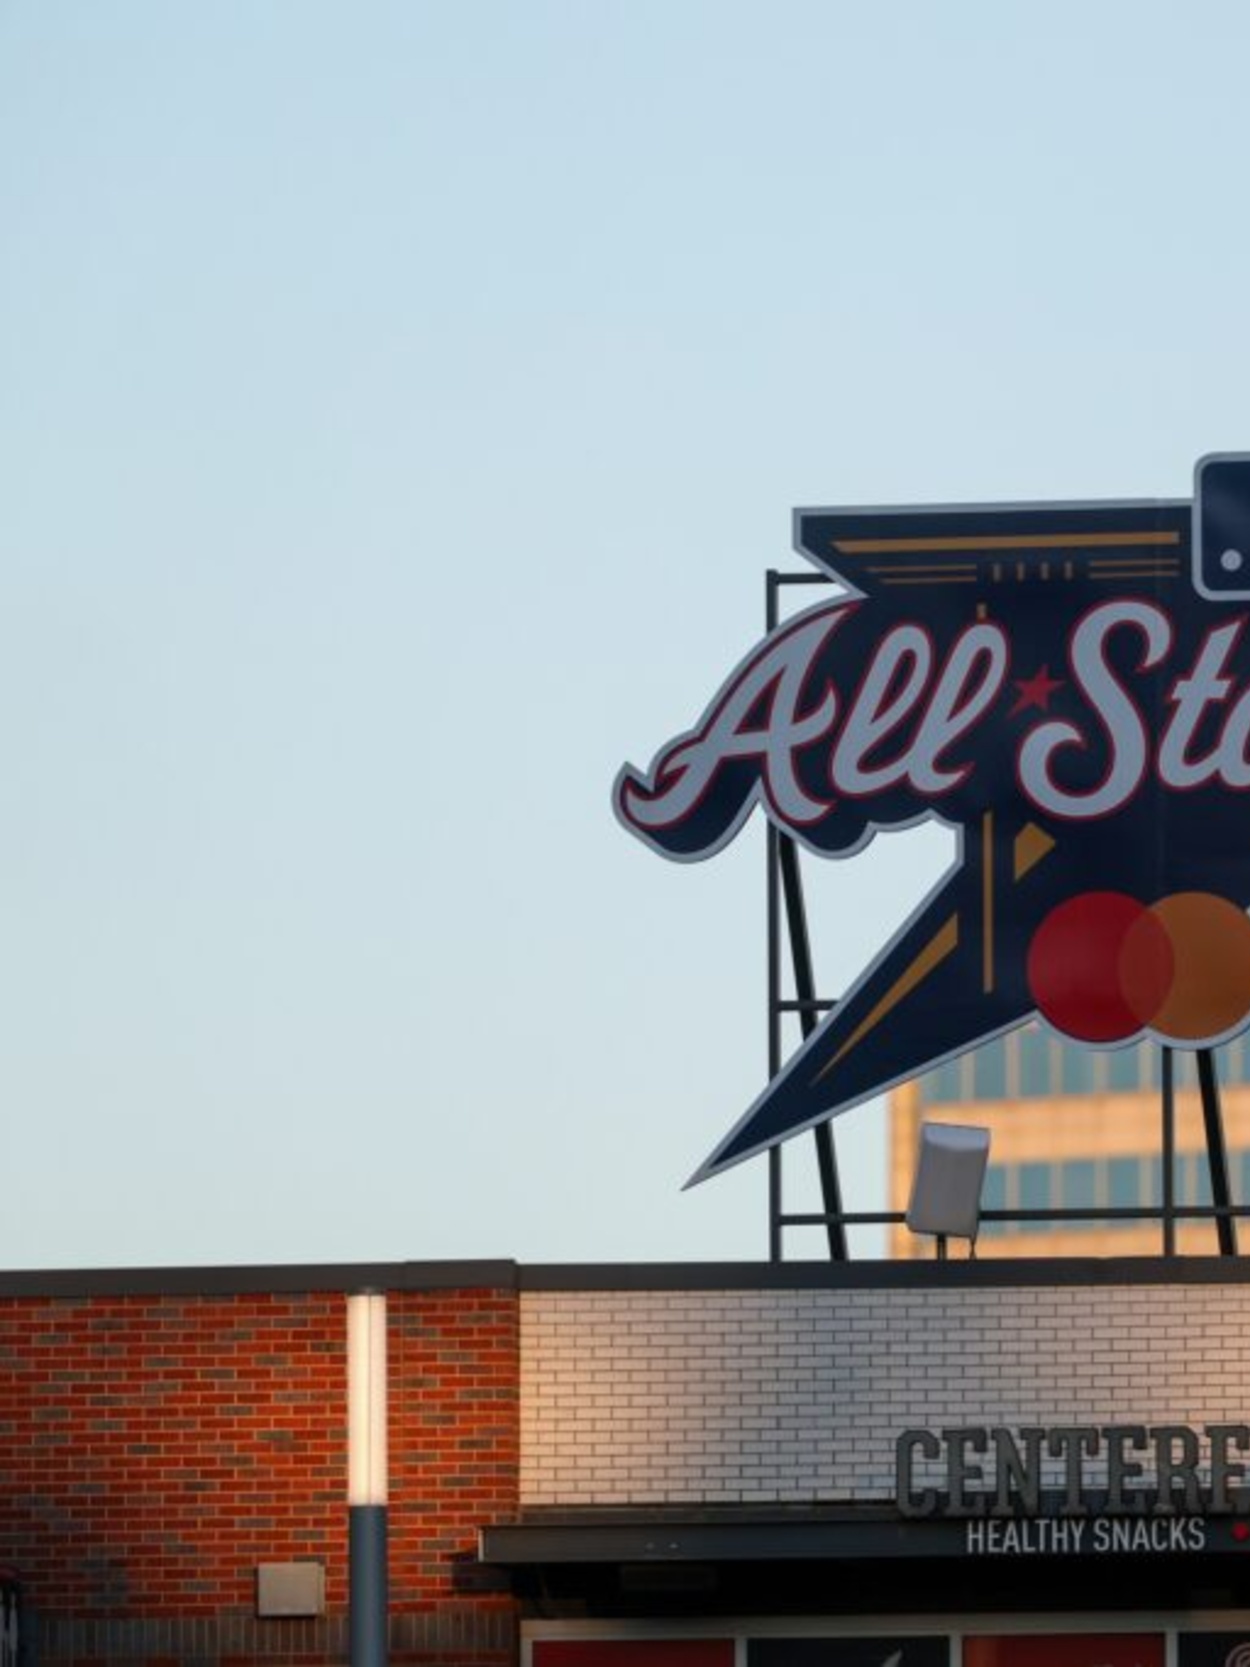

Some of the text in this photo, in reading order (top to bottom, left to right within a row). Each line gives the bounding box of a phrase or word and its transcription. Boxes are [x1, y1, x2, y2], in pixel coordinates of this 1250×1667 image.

[622, 600, 1007, 824] All
[965, 1516, 1084, 1554] HEALTHY
[1092, 1514, 1206, 1552] SNACKS
